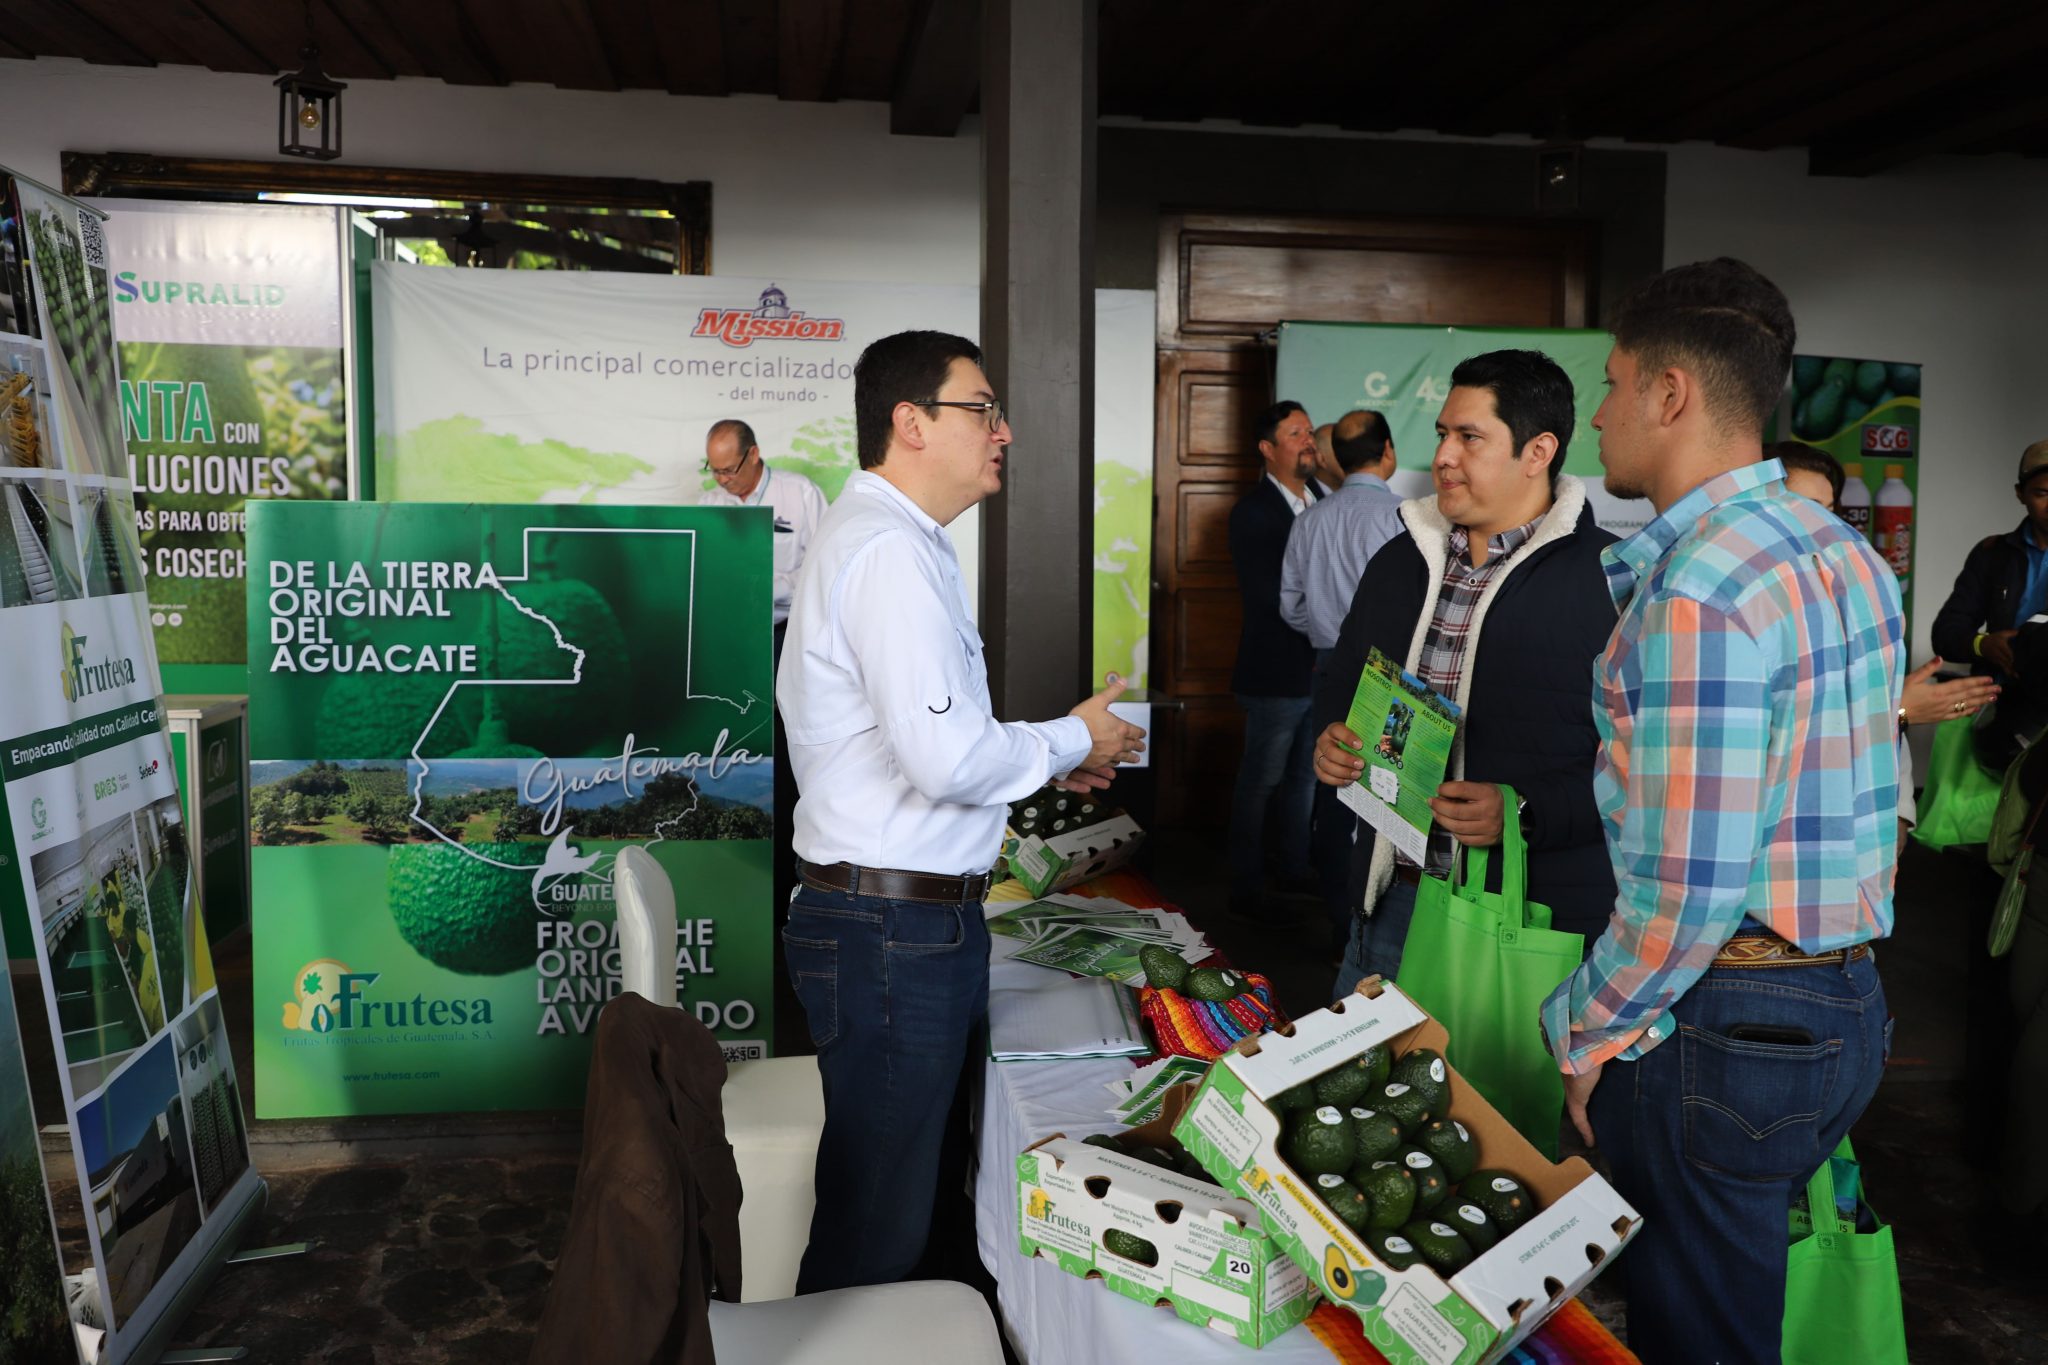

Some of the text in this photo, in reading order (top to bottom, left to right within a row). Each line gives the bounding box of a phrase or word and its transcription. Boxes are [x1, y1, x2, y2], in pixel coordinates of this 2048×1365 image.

[113, 271, 287, 308] SUPRALID
[690, 307, 844, 348] Mission
[483, 347, 854, 379] La principal comercializado
[729, 386, 755, 401] del
[761, 387, 817, 402] mundo
[222, 422, 260, 445] CON
[130, 453, 290, 497] LUCIONES
[158, 510, 203, 532] PARA
[269, 561, 499, 589] DE LA TIERRA
[269, 588, 451, 617] ORIGINAL
[270, 617, 332, 644] DEL
[71, 635, 136, 697] Frutesa
[269, 644, 477, 674] AGUACATE
[1364, 668, 1394, 690] NOSOTROS
[100, 723, 115, 738] con
[115, 711, 140, 733] Calidad
[1420, 708, 1452, 732] ABOUT US
[524, 728, 764, 836] Guatemala
[551, 903, 593, 913] BEYOND
[330, 972, 494, 1030] Frutesa
[284, 1036, 320, 1048] Frutas
[325, 1033, 384, 1047] Tropicales
[386, 1034, 400, 1044] de
[342, 1070, 441, 1082] www.frutesa.com
[1045, 1200, 1090, 1237] Frutesa
[1257, 1180, 1298, 1230] Frutesa
[1280, 1176, 1314, 1211] Delicious
[1311, 1208, 1332, 1230] Hass
[1330, 1228, 1366, 1266] Avocados
[1229, 1261, 1250, 1274] 20
[1401, 1307, 1448, 1351] GUATEMALA
